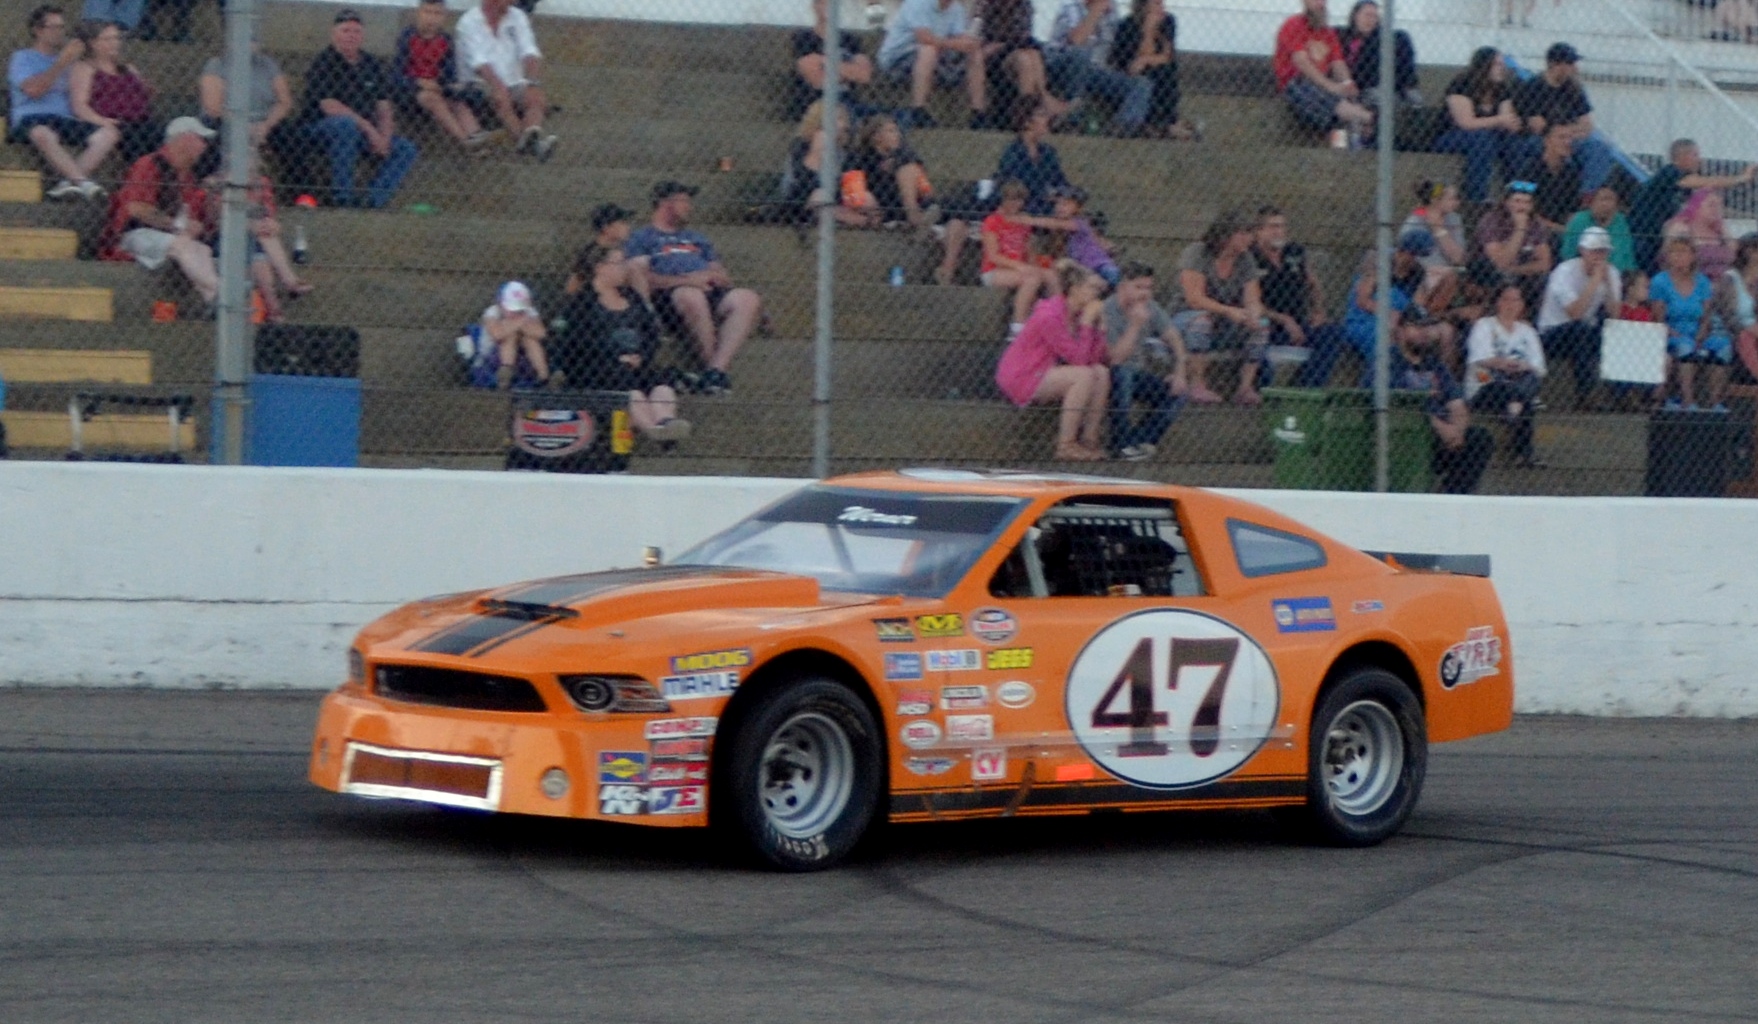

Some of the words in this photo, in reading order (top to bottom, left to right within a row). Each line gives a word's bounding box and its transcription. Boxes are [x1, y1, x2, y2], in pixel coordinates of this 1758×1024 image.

[675, 650, 749, 670] MOOG
[663, 672, 741, 696] MAHLE
[1091, 637, 1240, 758] 47
